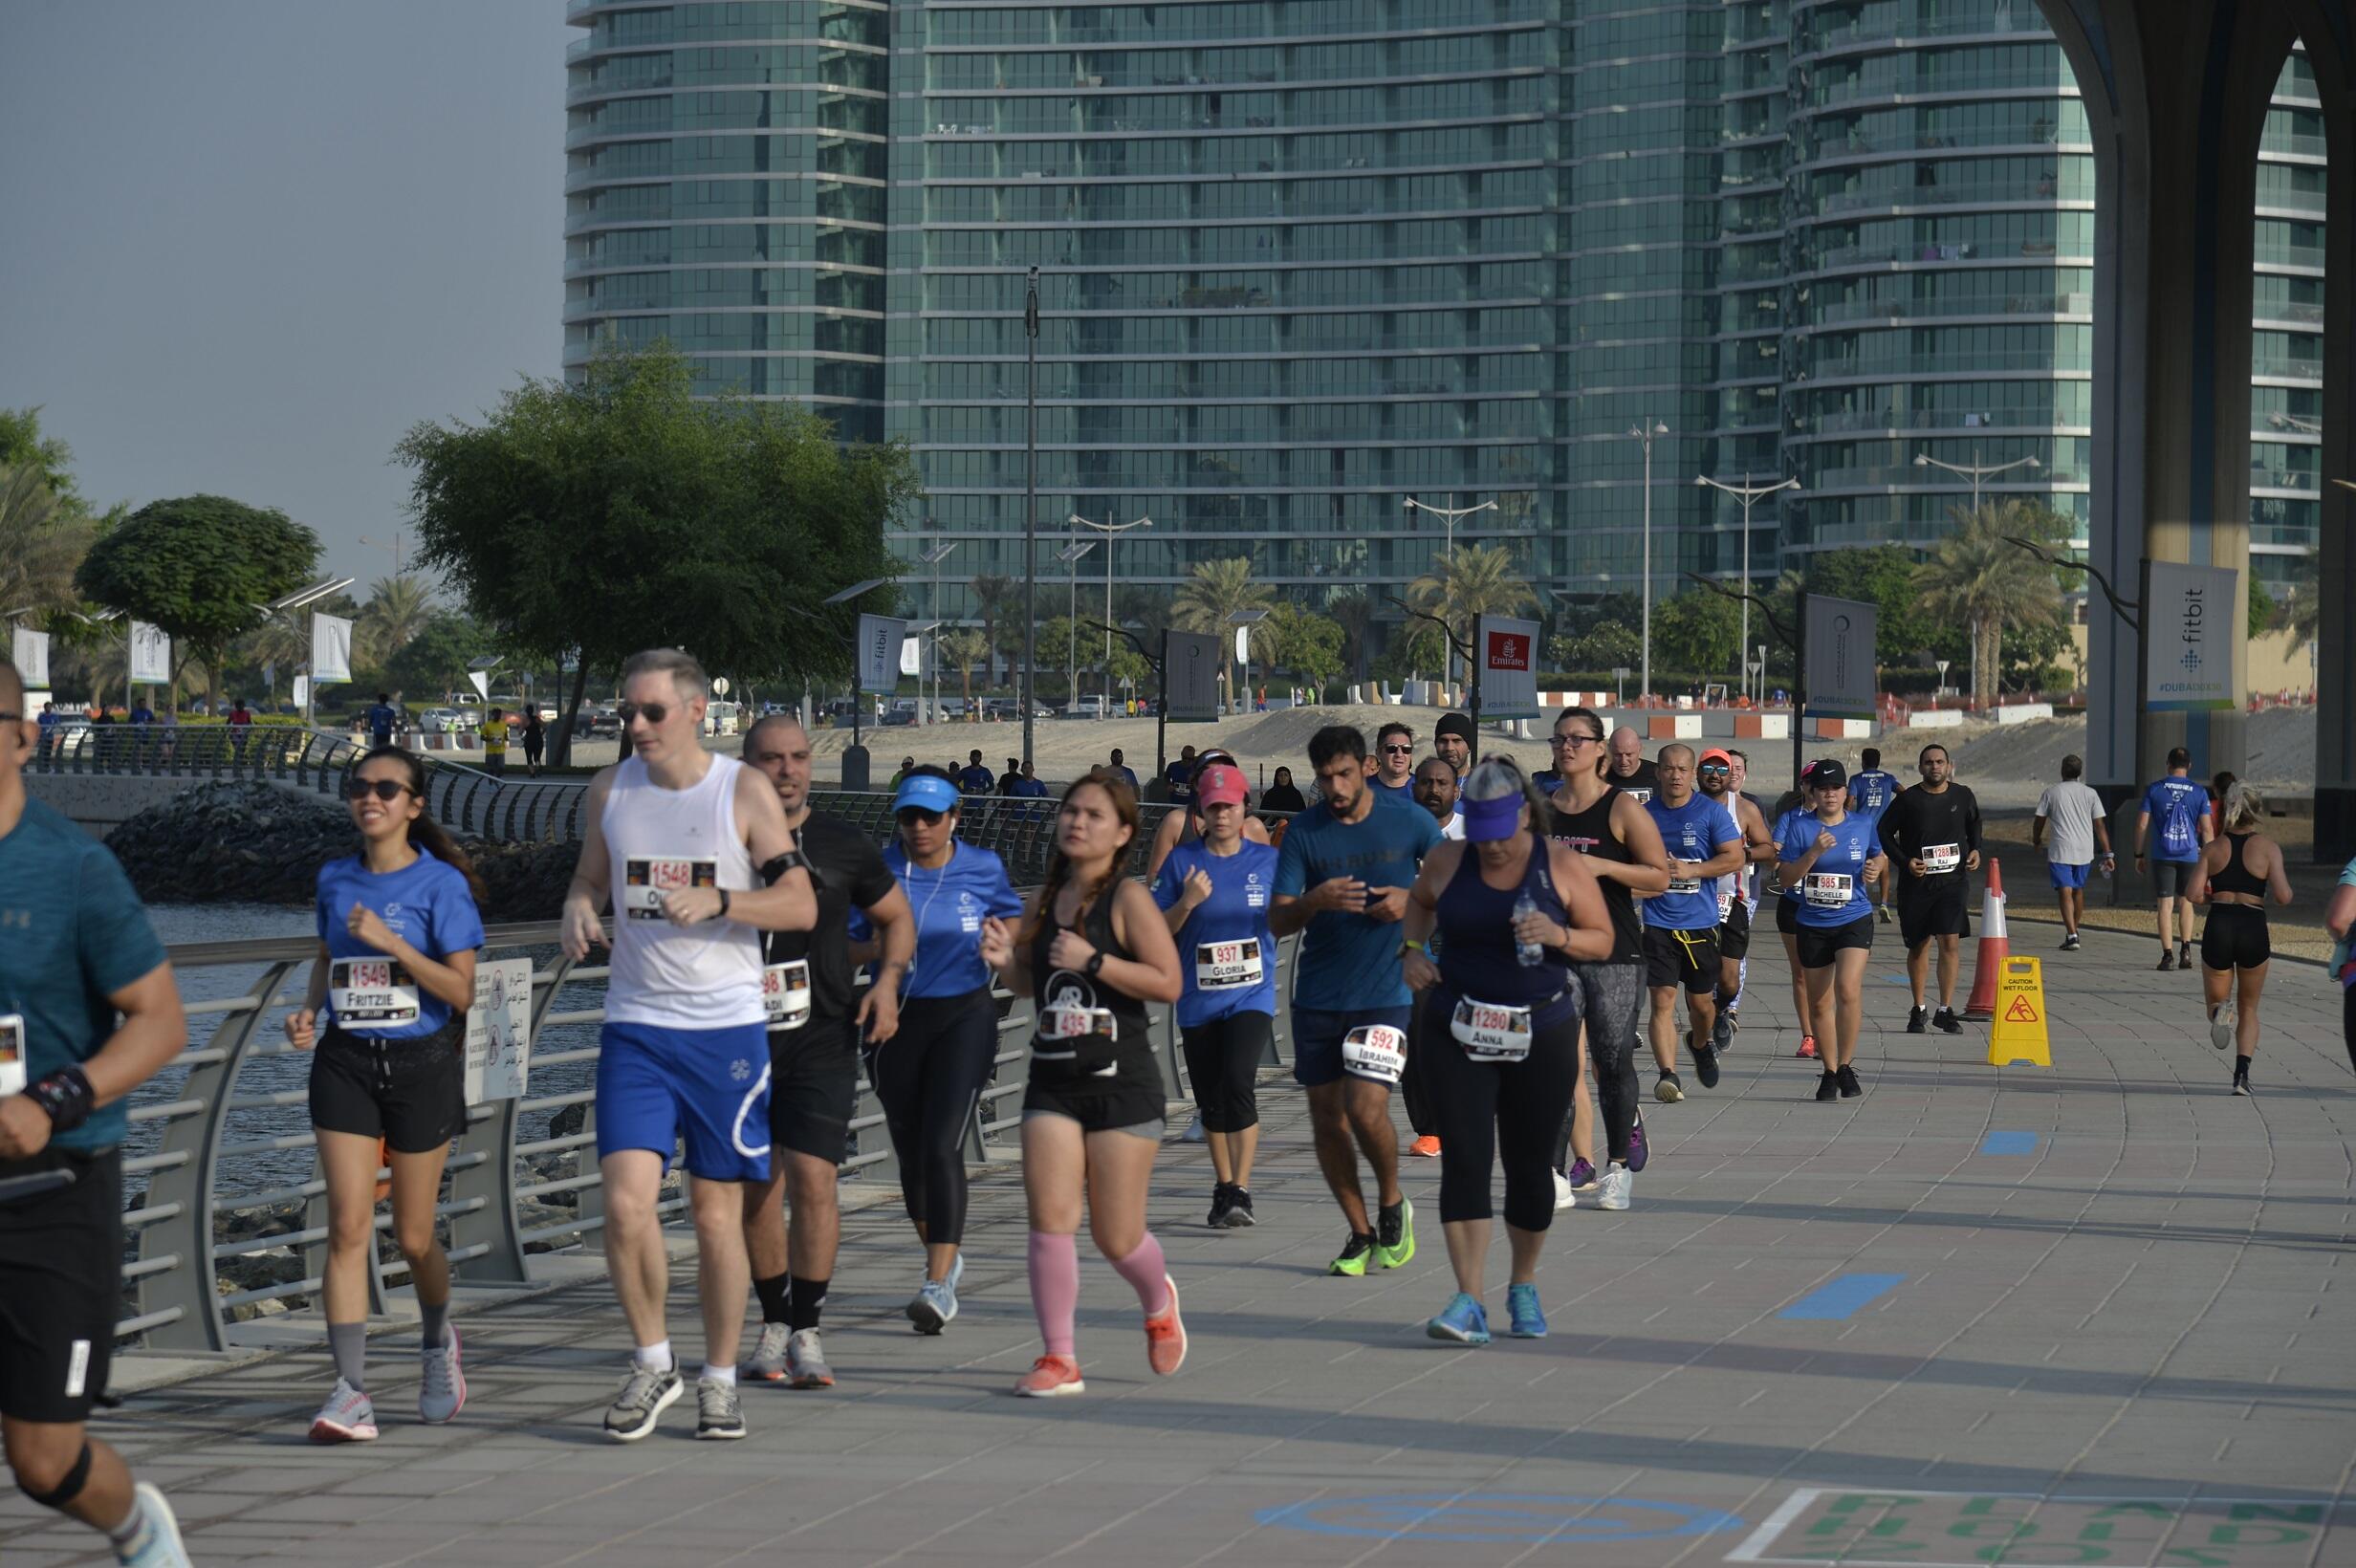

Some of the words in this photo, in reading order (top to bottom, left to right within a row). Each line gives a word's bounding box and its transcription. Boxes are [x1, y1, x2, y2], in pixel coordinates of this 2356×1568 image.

[2182, 589, 2202, 643] fitbit
[875, 628, 888, 658] fitbit
[1492, 656, 1525, 666] Emirates
[1934, 847, 1950, 859] 1288
[652, 862, 690, 885] 1548
[1821, 877, 1836, 888] 985
[1813, 889, 1843, 899] RICHELLE
[1216, 946, 1237, 963] 937
[353, 964, 387, 986] 1549
[1212, 965, 1247, 976] GLORIA
[347, 992, 395, 1007] FRITZIE
[1473, 1009, 1507, 1030] 1280
[1371, 1029, 1393, 1050] 592
[1472, 1031, 1503, 1046] ANNA
[1359, 1047, 1398, 1065] IBRAHIM
[1804, 1516, 2310, 1546] HOLD
